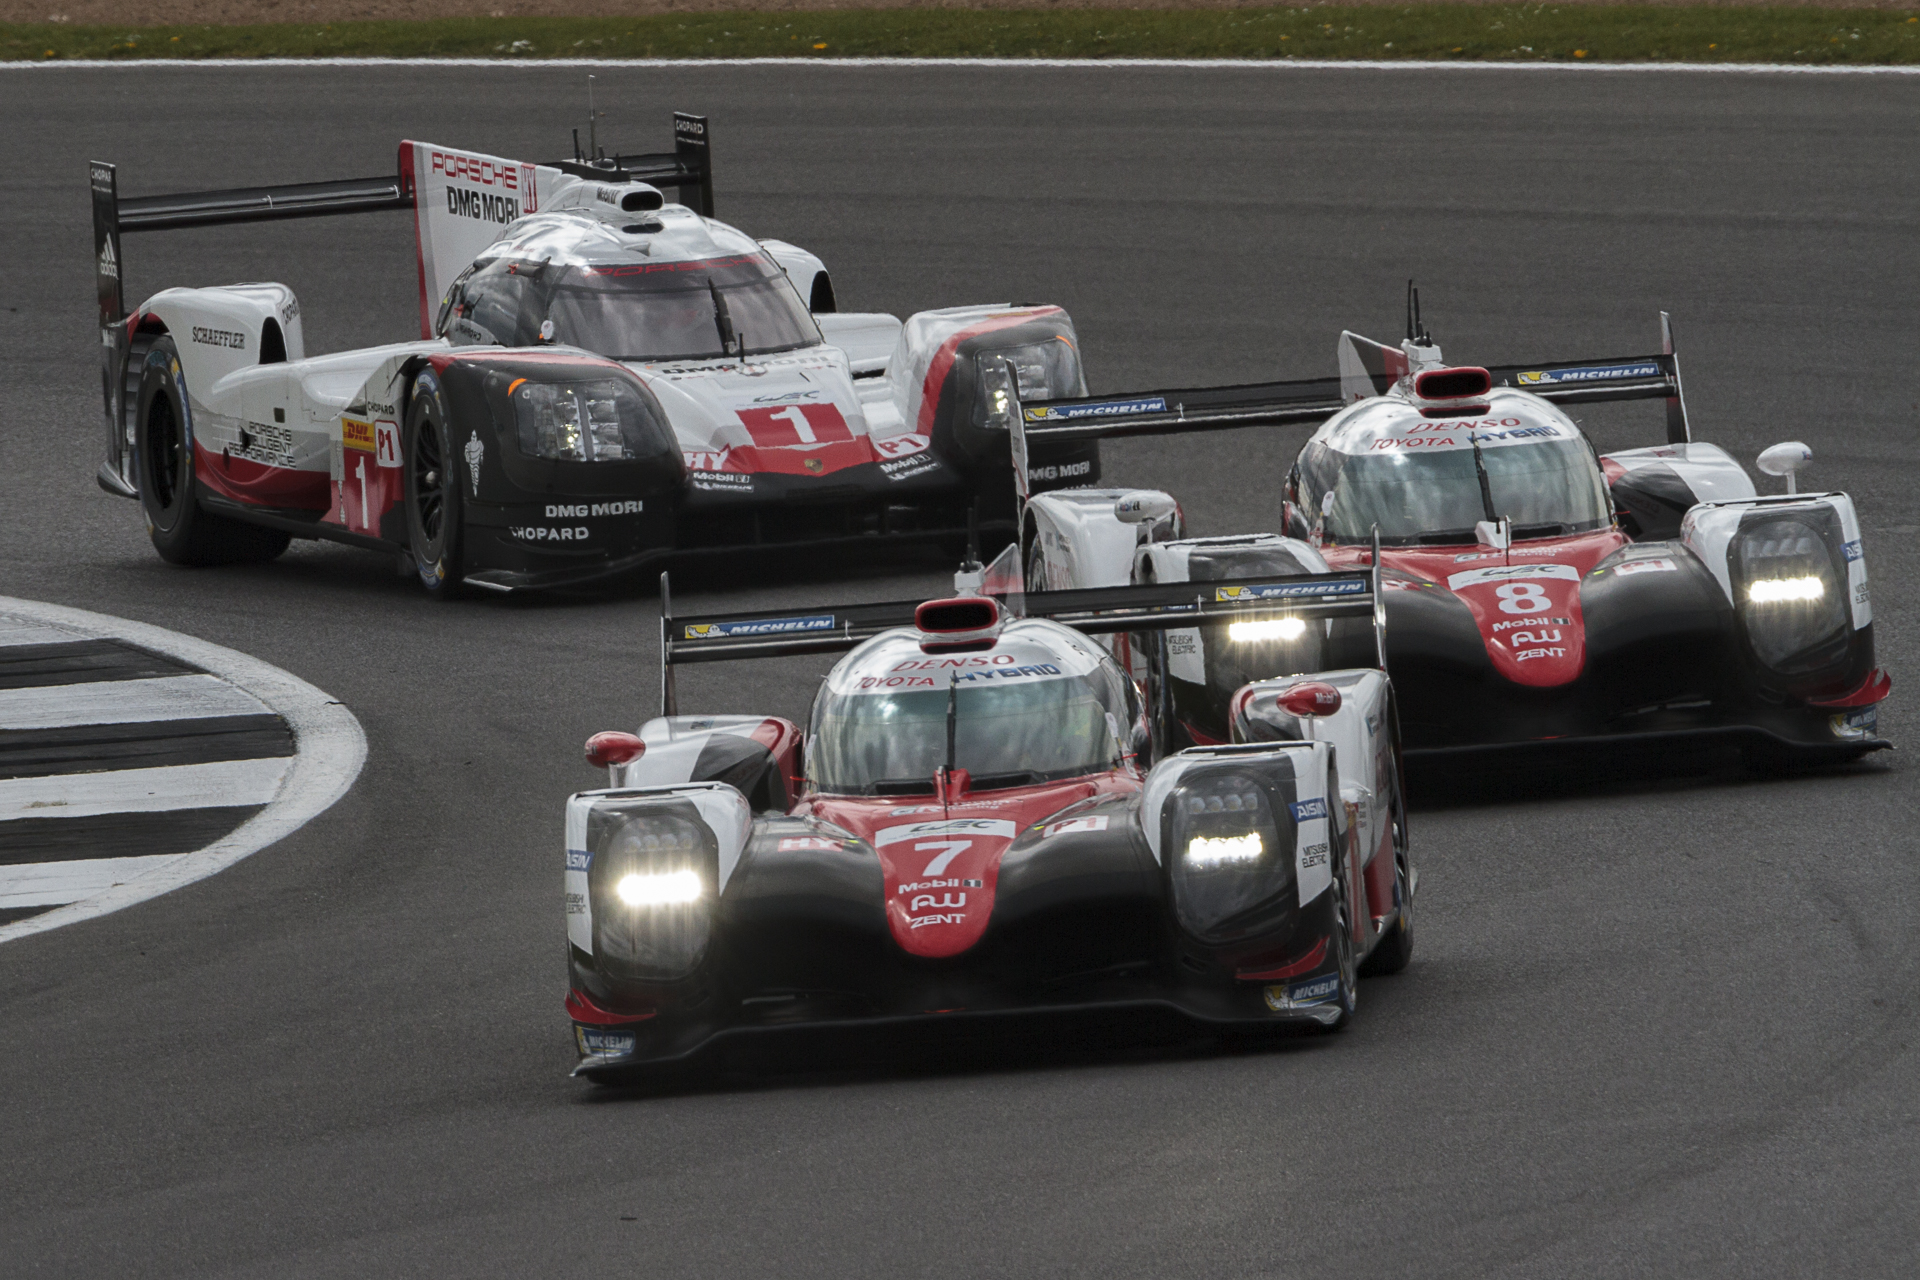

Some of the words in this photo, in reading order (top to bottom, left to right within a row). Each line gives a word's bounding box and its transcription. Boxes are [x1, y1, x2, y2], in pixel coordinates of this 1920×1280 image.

[676, 119, 704, 135] CHOPARD
[432, 151, 518, 190] PORSCHE
[447, 185, 481, 219] DMG
[482, 193, 520, 226] MORI
[585, 254, 767, 279] PORSCHE
[192, 326, 246, 350] SCHAEFFLER
[1562, 367, 1656, 381] MICHELIN
[368, 401, 396, 416] CHOPARD
[1068, 402, 1162, 417] MICHELIN
[249, 421, 292, 441] PORSCHE
[345, 421, 371, 442] DHL
[769, 405, 817, 443] 1
[1406, 417, 1522, 434] DENSO
[378, 428, 395, 462] P1
[878, 437, 924, 454] P1
[1369, 437, 1456, 451] TOYOTA
[1466, 425, 1561, 444] HYBRID
[684, 449, 729, 471] HY
[880, 456, 919, 474] Mobil
[693, 471, 735, 483] Mobil
[1028, 465, 1058, 481] MG
[1060, 460, 1091, 478] MORI
[355, 455, 369, 530] 1
[545, 504, 589, 518] DMG
[591, 500, 643, 516] MORI
[1621, 560, 1664, 571] P1
[1261, 583, 1362, 597] MICHELIN
[1495, 582, 1552, 614] 8
[730, 620, 831, 634] MICHELIN
[1492, 617, 1549, 632] Mobil
[891, 655, 1015, 672] DENSO
[1516, 647, 1566, 662] ZENT
[854, 676, 935, 689] TOYOTA
[950, 663, 1061, 683] HYBRID
[1296, 801, 1326, 819] AISIN
[1053, 817, 1097, 832] P1
[782, 837, 839, 848] HY
[914, 840, 973, 877] 7
[898, 878, 959, 894] Mobil
[910, 913, 966, 929] ZENT
